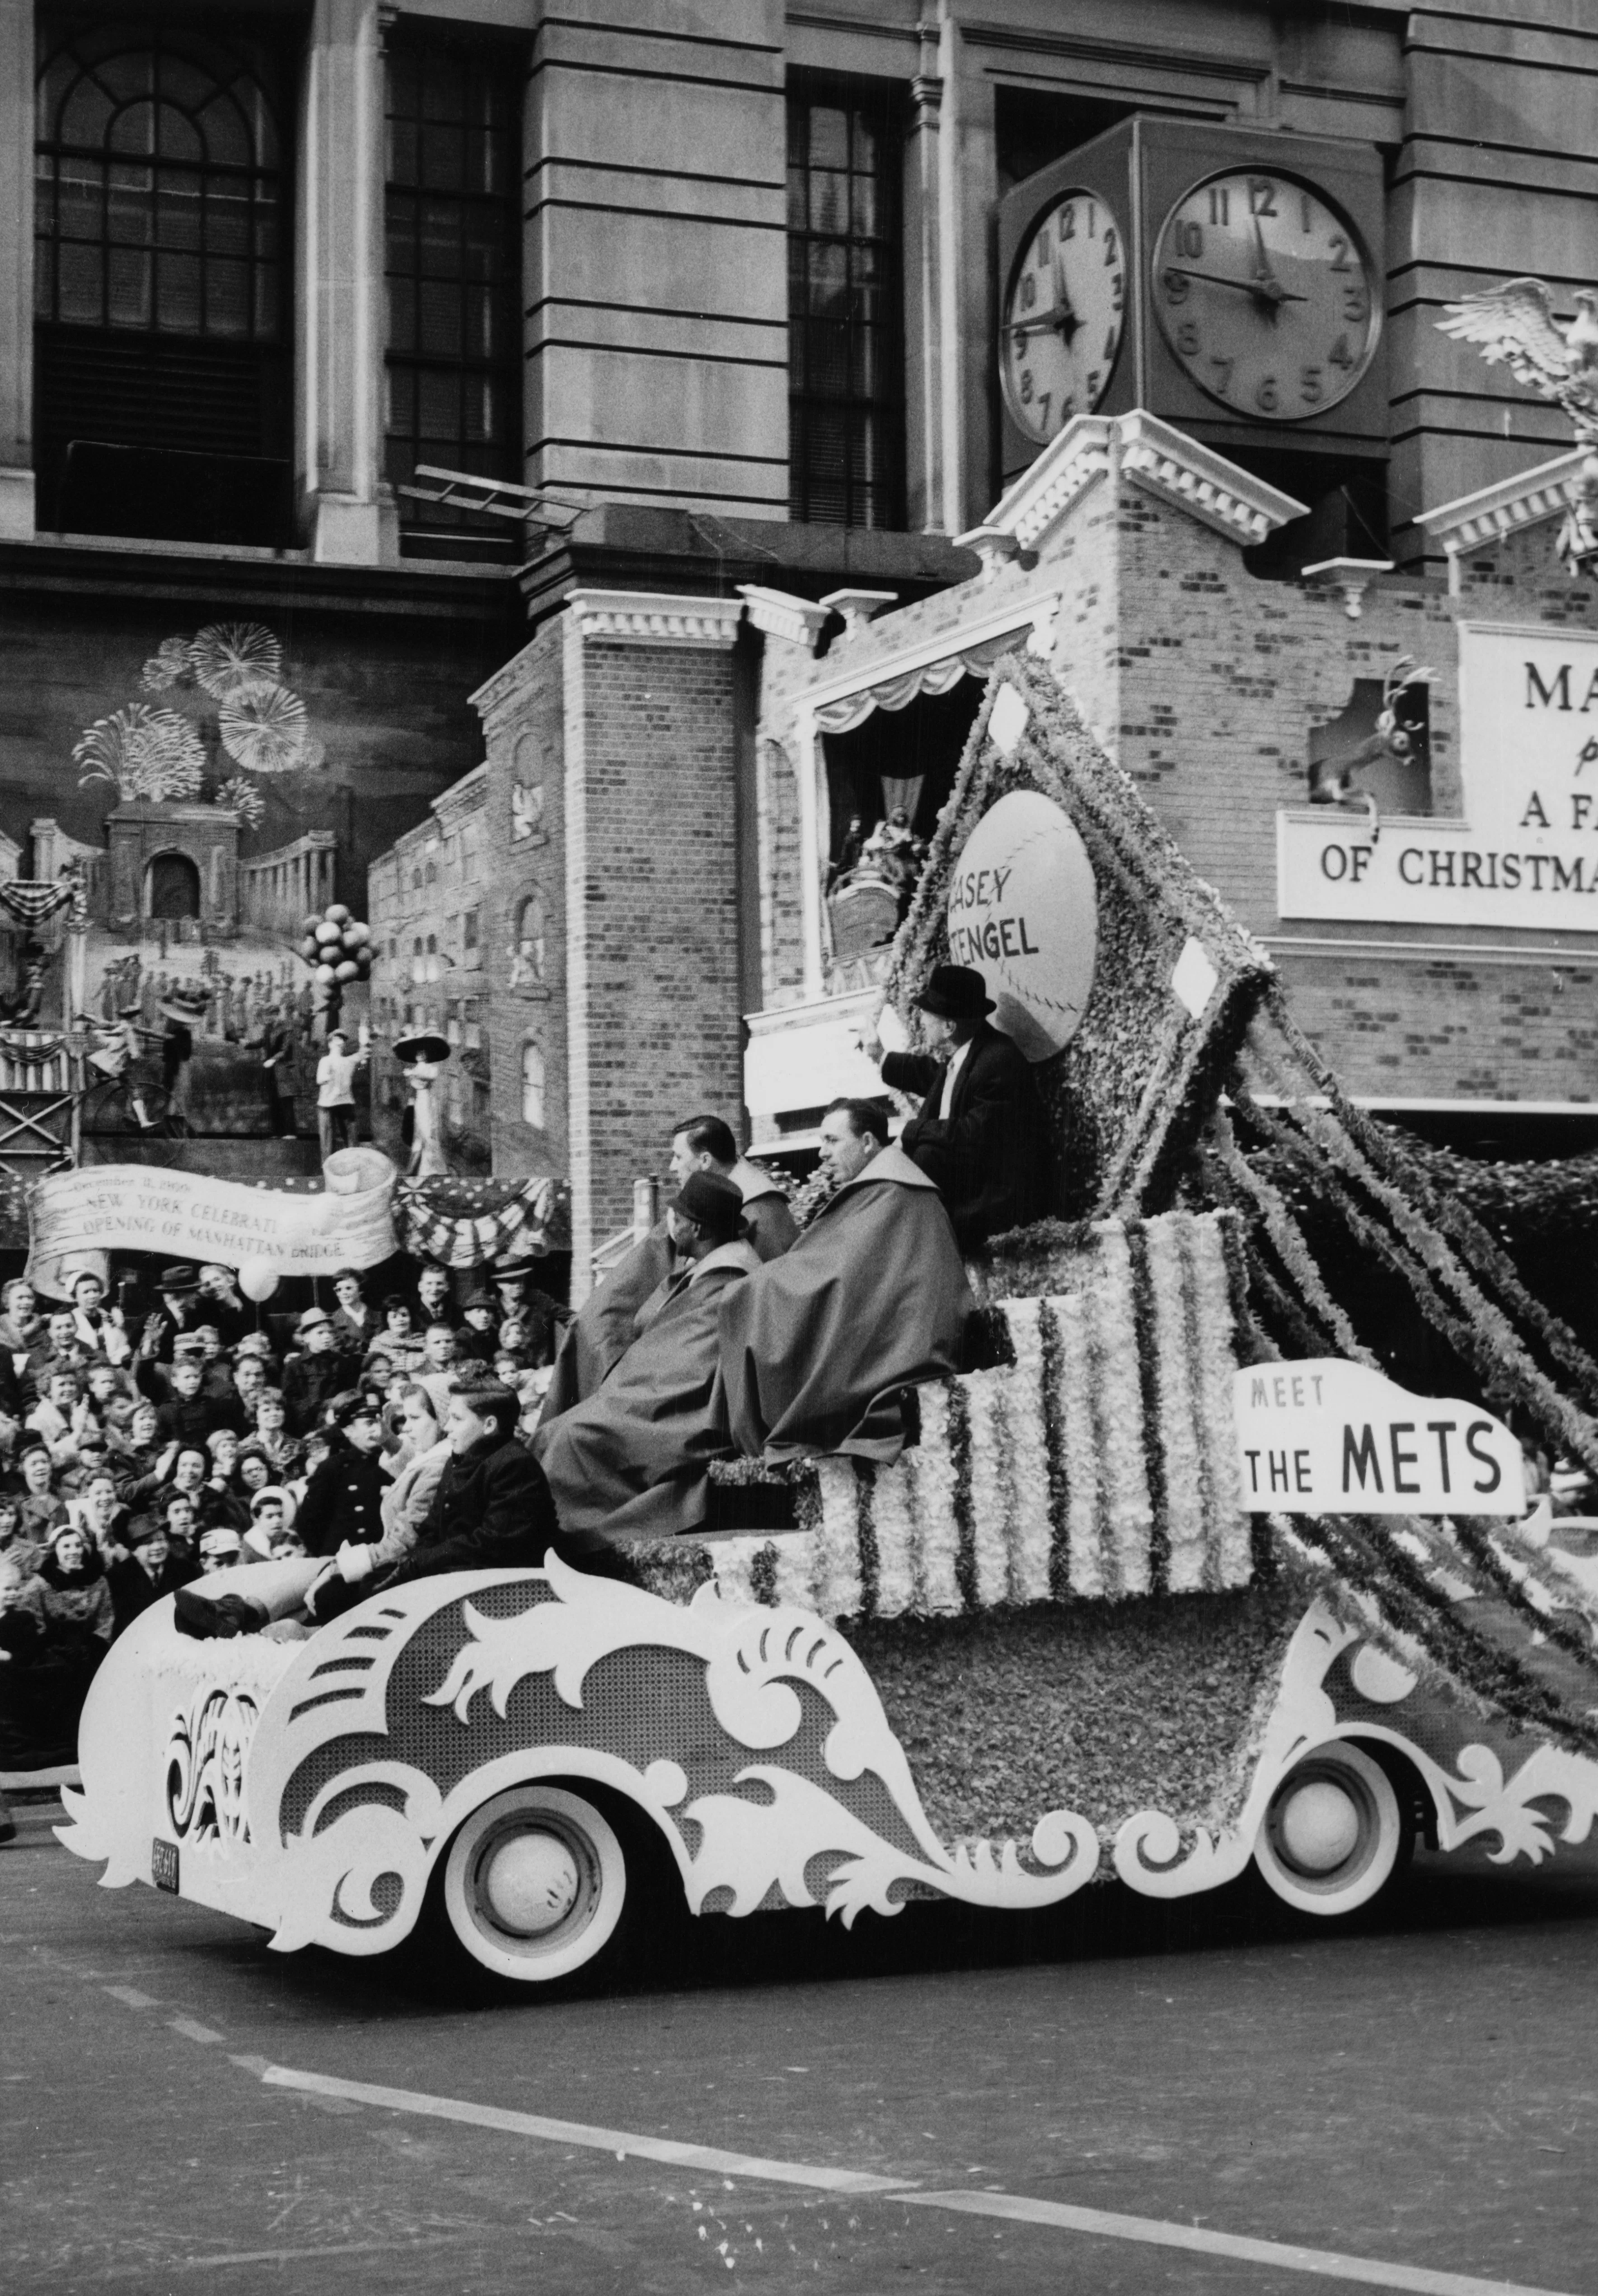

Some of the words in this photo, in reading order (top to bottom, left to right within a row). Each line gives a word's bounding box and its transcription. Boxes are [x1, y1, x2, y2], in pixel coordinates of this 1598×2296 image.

[1209, 188, 1229, 226] 11
[1249, 179, 1278, 218] 12
[1300, 195, 1312, 233] 1
[1059, 203, 1076, 243] 12
[1088, 202, 1095, 239] 1
[1176, 219, 1204, 259] 10
[1038, 230, 1051, 268] 11
[1103, 227, 1117, 266] 2
[1328, 235, 1352, 272] 2
[1020, 272, 1036, 312] 10
[1111, 272, 1122, 311] 3
[1344, 286, 1366, 323] 3
[1177, 323, 1203, 356] 8
[1328, 333, 1354, 371] 4
[1020, 368, 1034, 404] 8
[1210, 356, 1235, 394] 7
[1256, 376, 1279, 412] 6
[1299, 366, 1324, 404] 5
[1038, 391, 1052, 431] 7
[1519, 791, 1551, 828] A
[1570, 794, 1598, 831] F
[1322, 844, 1372, 882] OF
[87, 1193, 123, 1210] NEW
[137, 1194, 183, 1214] YORK
[83, 1215, 155, 1235] OPENING
[161, 1221, 183, 1236] OF
[189, 1227, 286, 1256] MANHATTAN
[291, 1242, 345, 1258] BRIDGE
[1251, 1375, 1324, 1408] MEET
[1244, 1450, 1313, 1493] THE
[1342, 1421, 1501, 1494] METS
